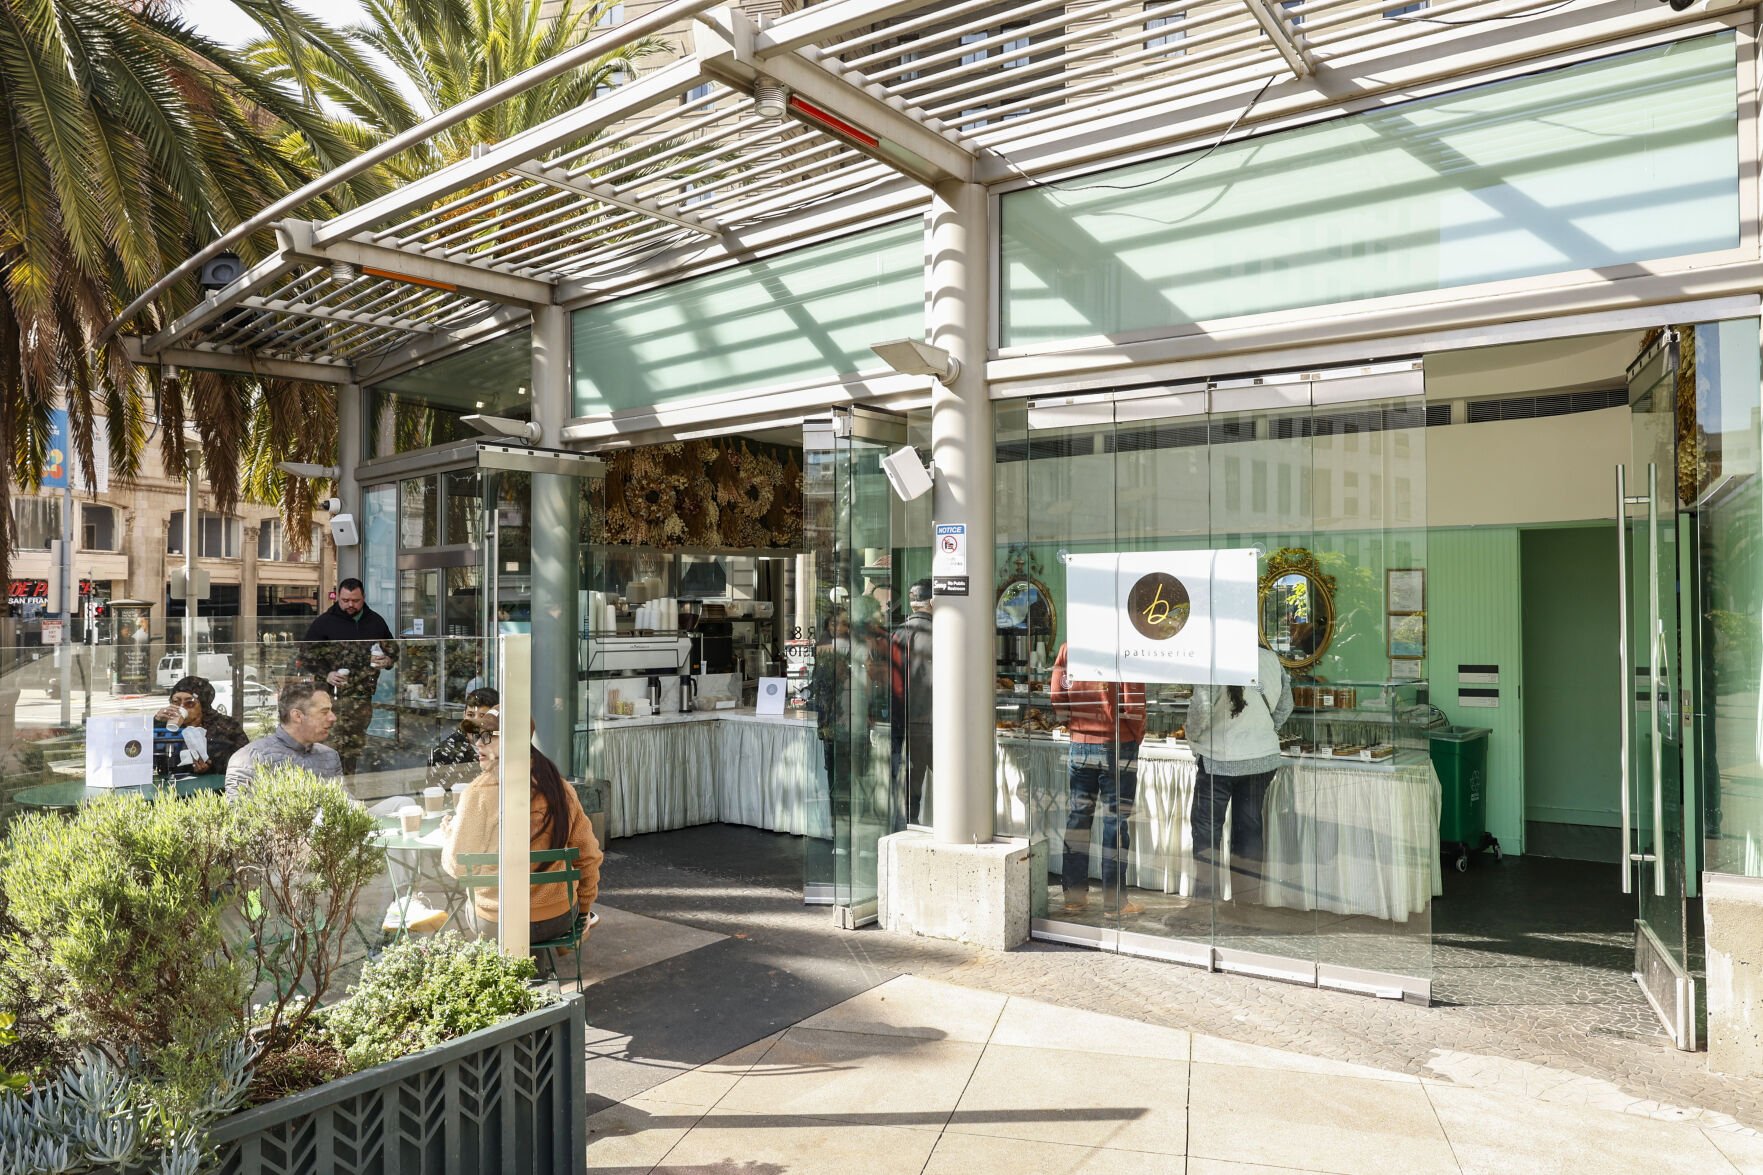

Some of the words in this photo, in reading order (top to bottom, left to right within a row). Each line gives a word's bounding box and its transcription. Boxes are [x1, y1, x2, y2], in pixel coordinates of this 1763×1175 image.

[938, 526, 963, 534] NOTICE
[8, 597, 26, 605] SAN
[1124, 649, 1195, 659] patisserie
